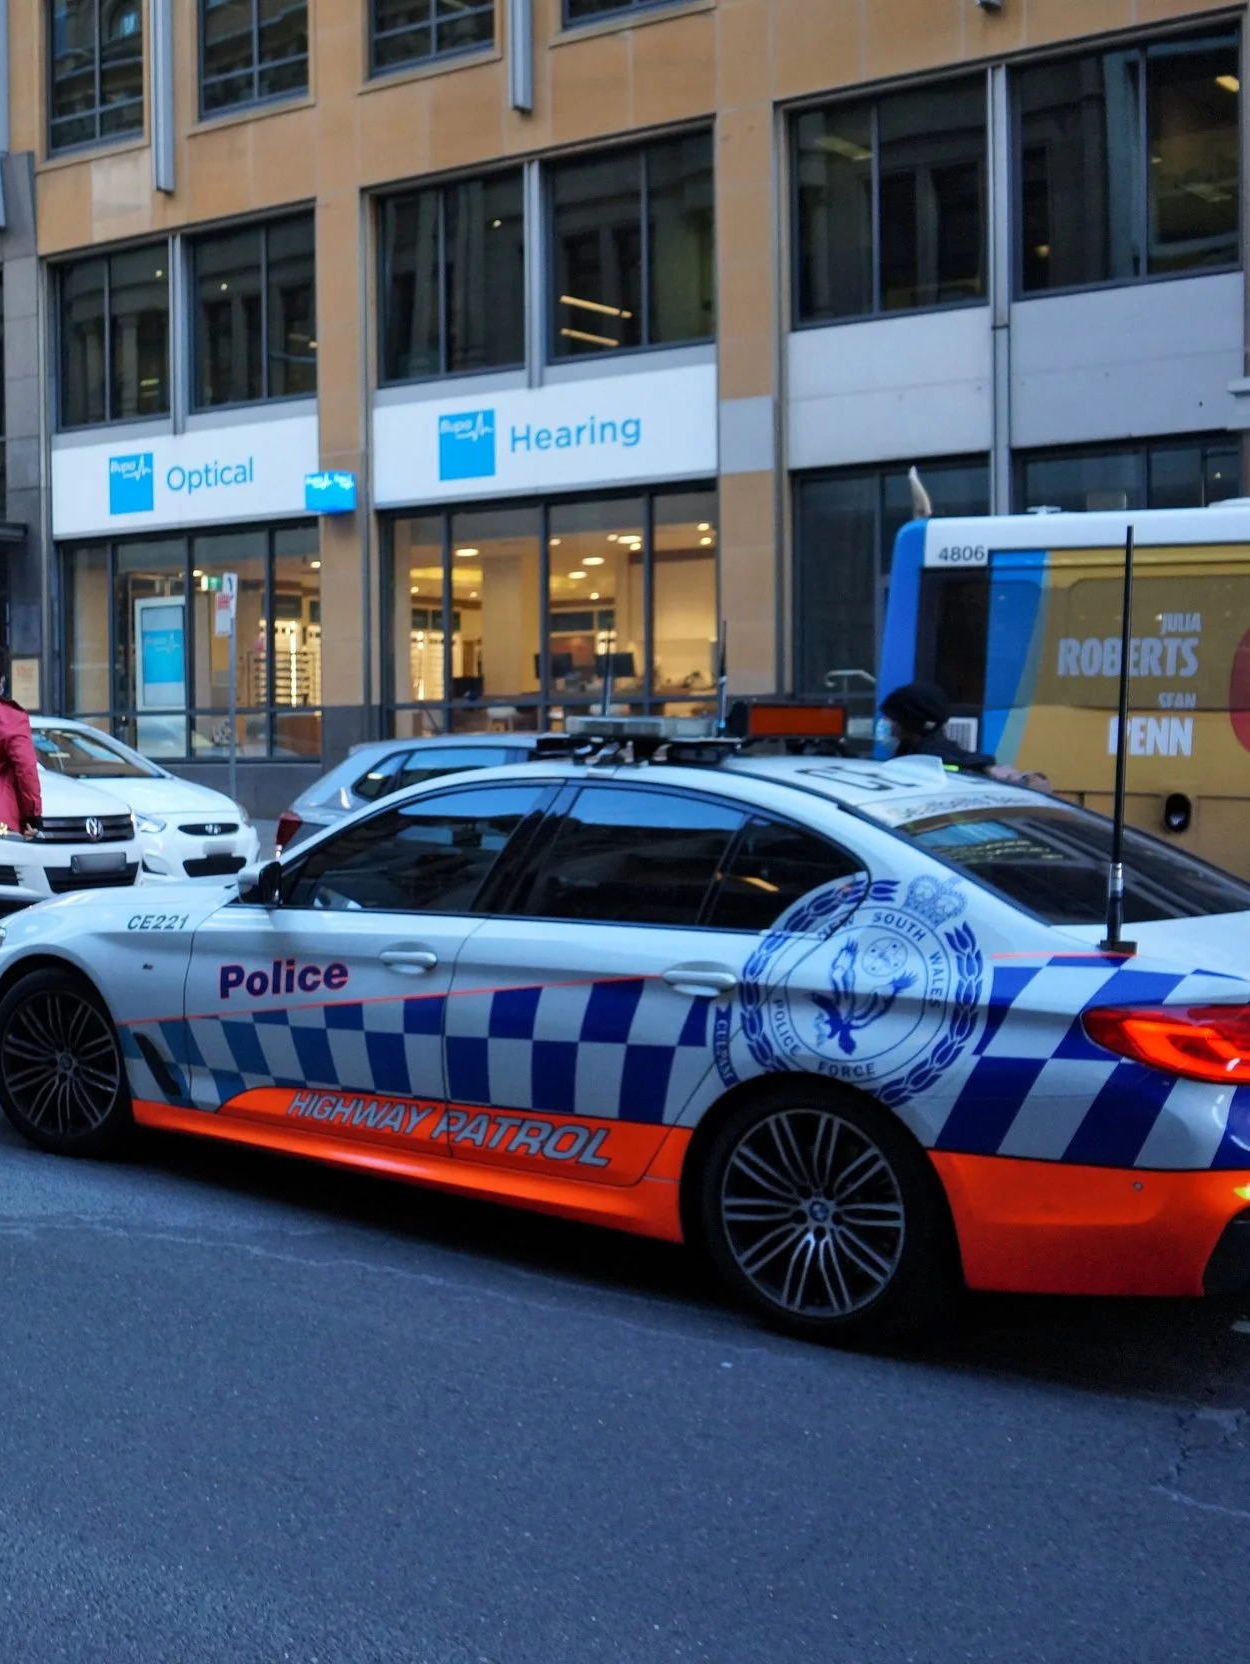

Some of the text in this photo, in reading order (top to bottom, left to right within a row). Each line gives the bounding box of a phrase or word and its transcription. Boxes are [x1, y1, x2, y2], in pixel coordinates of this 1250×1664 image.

[511, 415, 640, 453] Hearing
[167, 456, 253, 494] Optical
[938, 545, 985, 562] 4806
[1160, 612, 1202, 635] JULIA
[1057, 636, 1199, 678] ROBERTS
[1157, 692, 1197, 709] SEAN
[127, 914, 189, 930] CE221
[219, 957, 349, 1000] Police
[872, 911, 926, 942] SOUTH
[928, 951, 946, 1009] WALES
[773, 998, 877, 1077] POLICE FORCE
[287, 1091, 612, 1168] HIGHWAY PATROL
